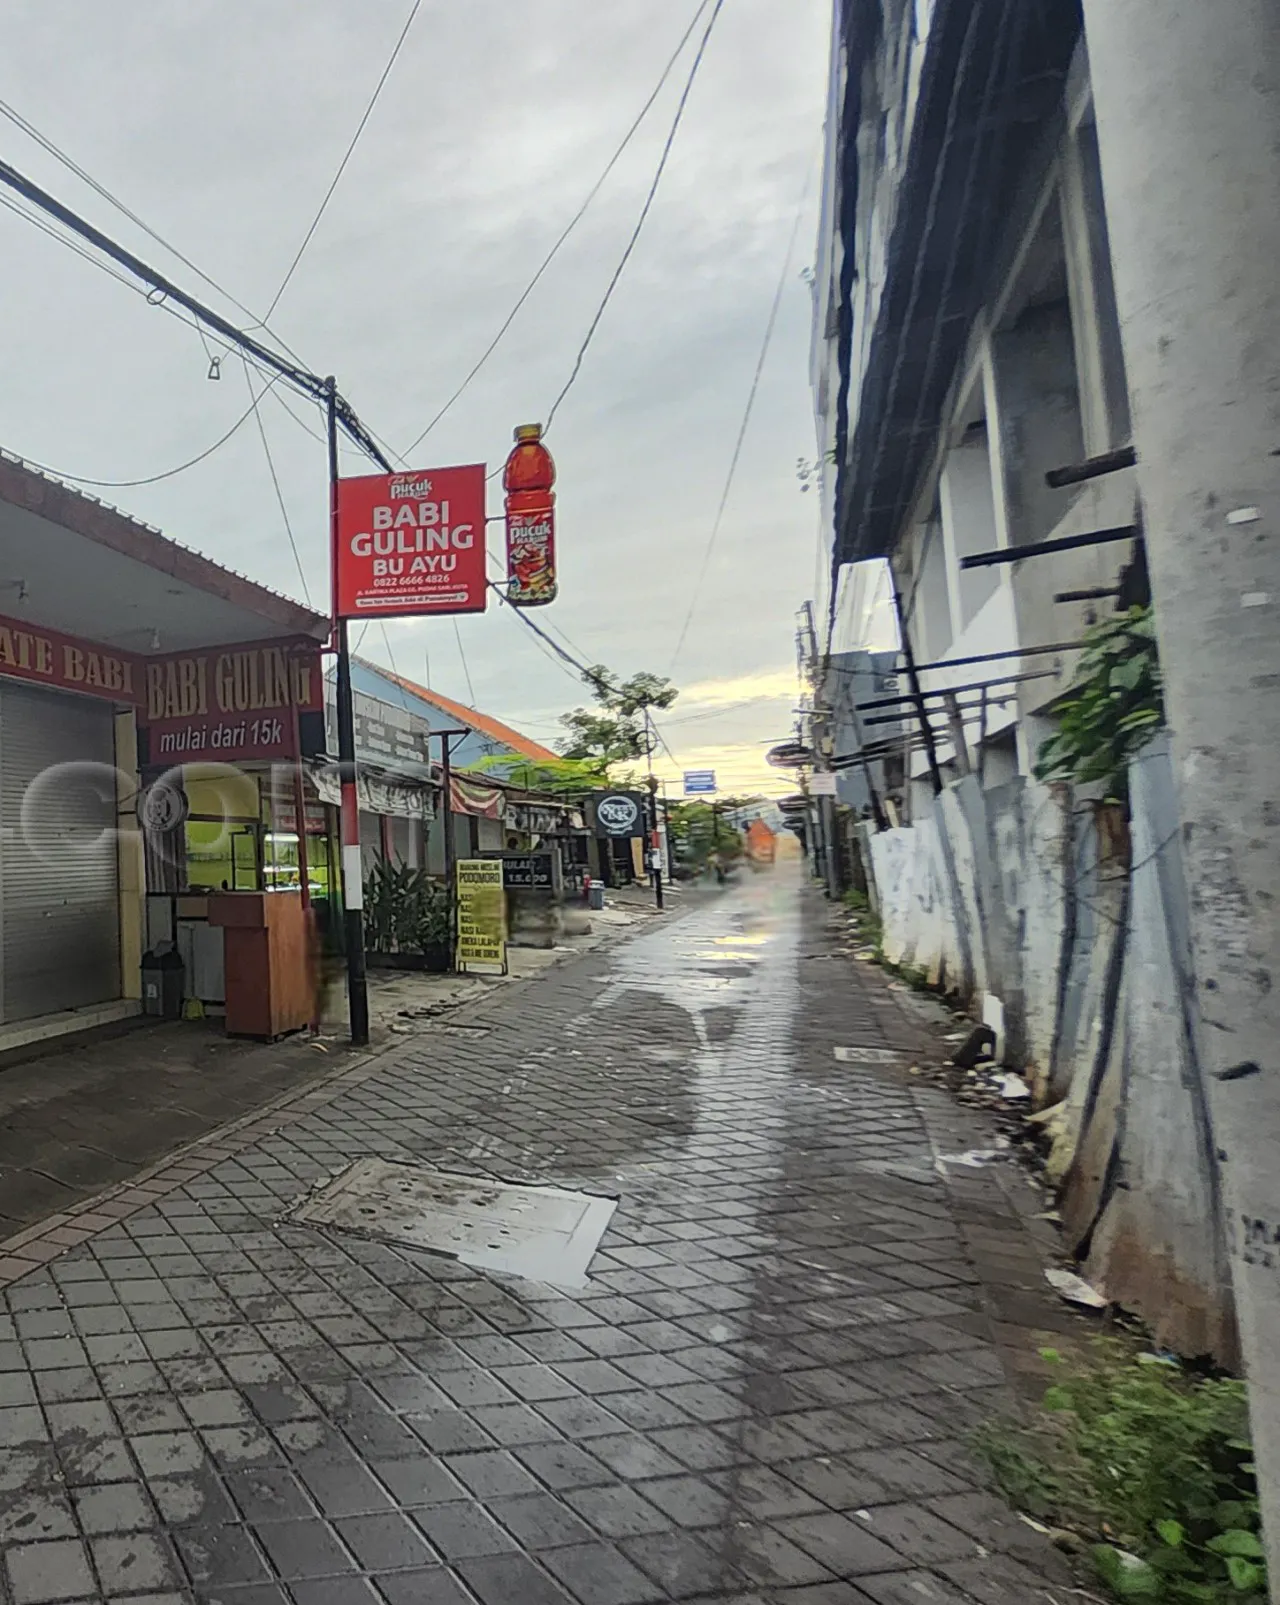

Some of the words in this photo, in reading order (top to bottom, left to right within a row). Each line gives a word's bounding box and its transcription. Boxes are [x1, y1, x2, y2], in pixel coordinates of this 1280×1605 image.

[373, 500, 450, 530] BABI
[350, 525, 474, 557] GULING
[373, 558, 404, 576] BU
[410, 554, 457, 573] AYU
[373, 577, 397, 587] 0822
[399, 576, 424, 586] 6666
[425, 575, 450, 584] 4826
[63, 644, 134, 695] BABI
[146, 657, 208, 721] BABI
[217, 643, 311, 714] GULING
[160, 723, 207, 754] mulai
[212, 721, 245, 749] dari
[249, 718, 283, 746] 15k
